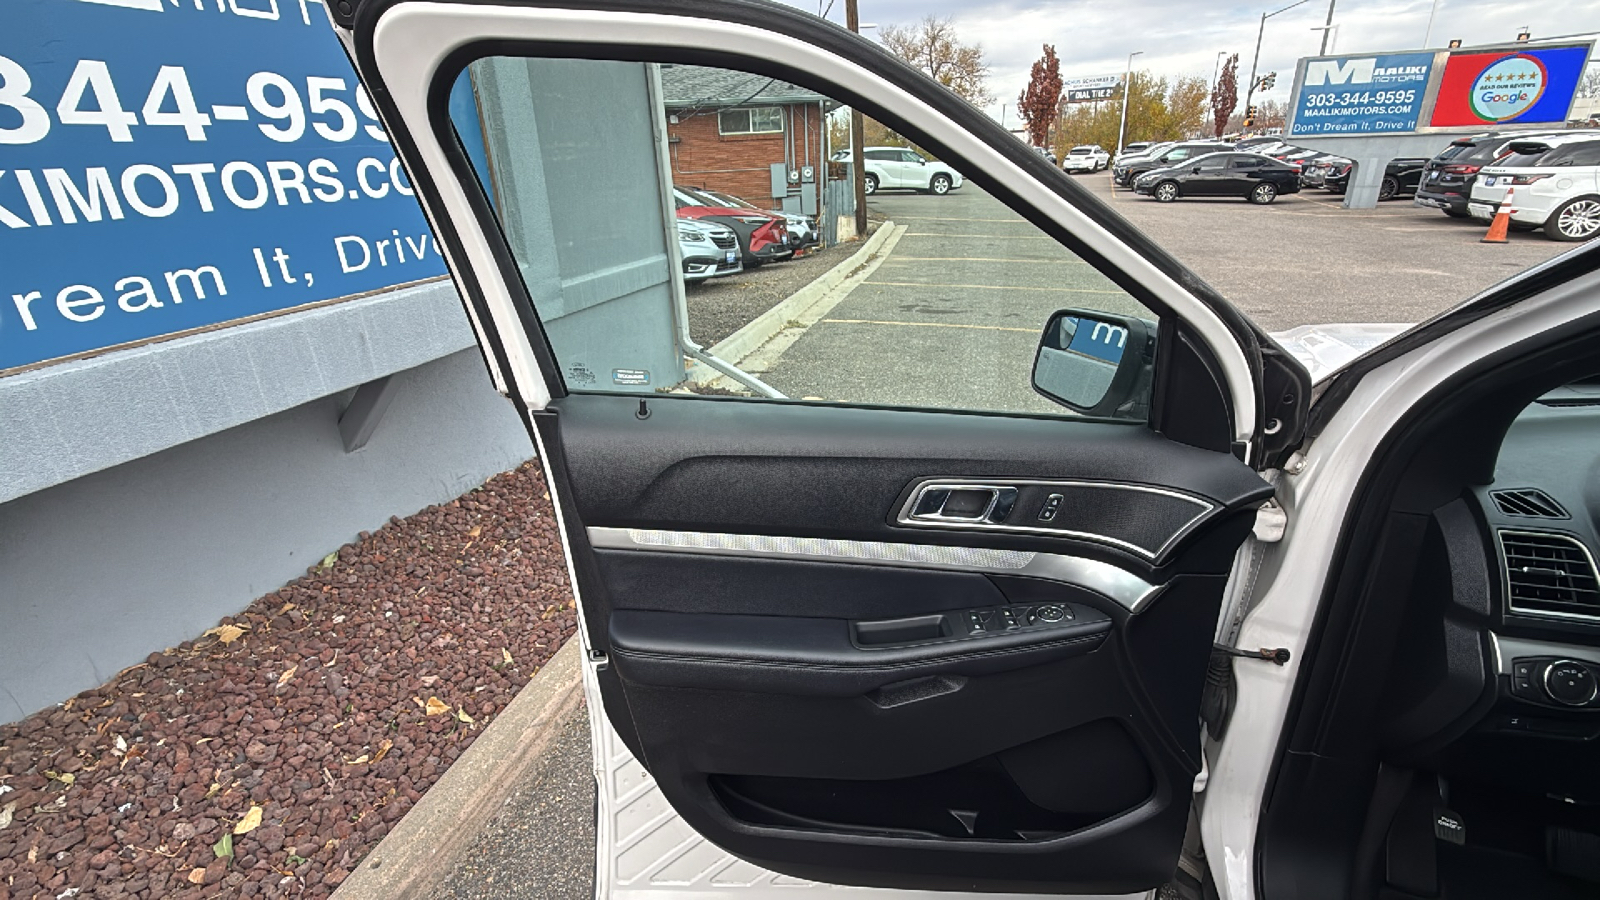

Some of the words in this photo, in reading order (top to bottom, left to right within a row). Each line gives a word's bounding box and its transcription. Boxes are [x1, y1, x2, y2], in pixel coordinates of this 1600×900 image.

[1372, 75, 1424, 83] MOTORS
[1075, 90, 1091, 99] DIAL
[1306, 90, 1416, 107] 303-344-9595
[1481, 90, 1528, 104] Google
[1304, 105, 1412, 117] MAALIKIMOTORS.COM
[1293, 122, 1321, 132] Don't
[1323, 122, 1358, 131] Dream
[1375, 121, 1404, 129] Drive
[1407, 120, 1415, 129] It
[0, 156, 415, 229] IMOTORS.C
[0, 265, 228, 332] ream
[252, 246, 315, 288] It,
